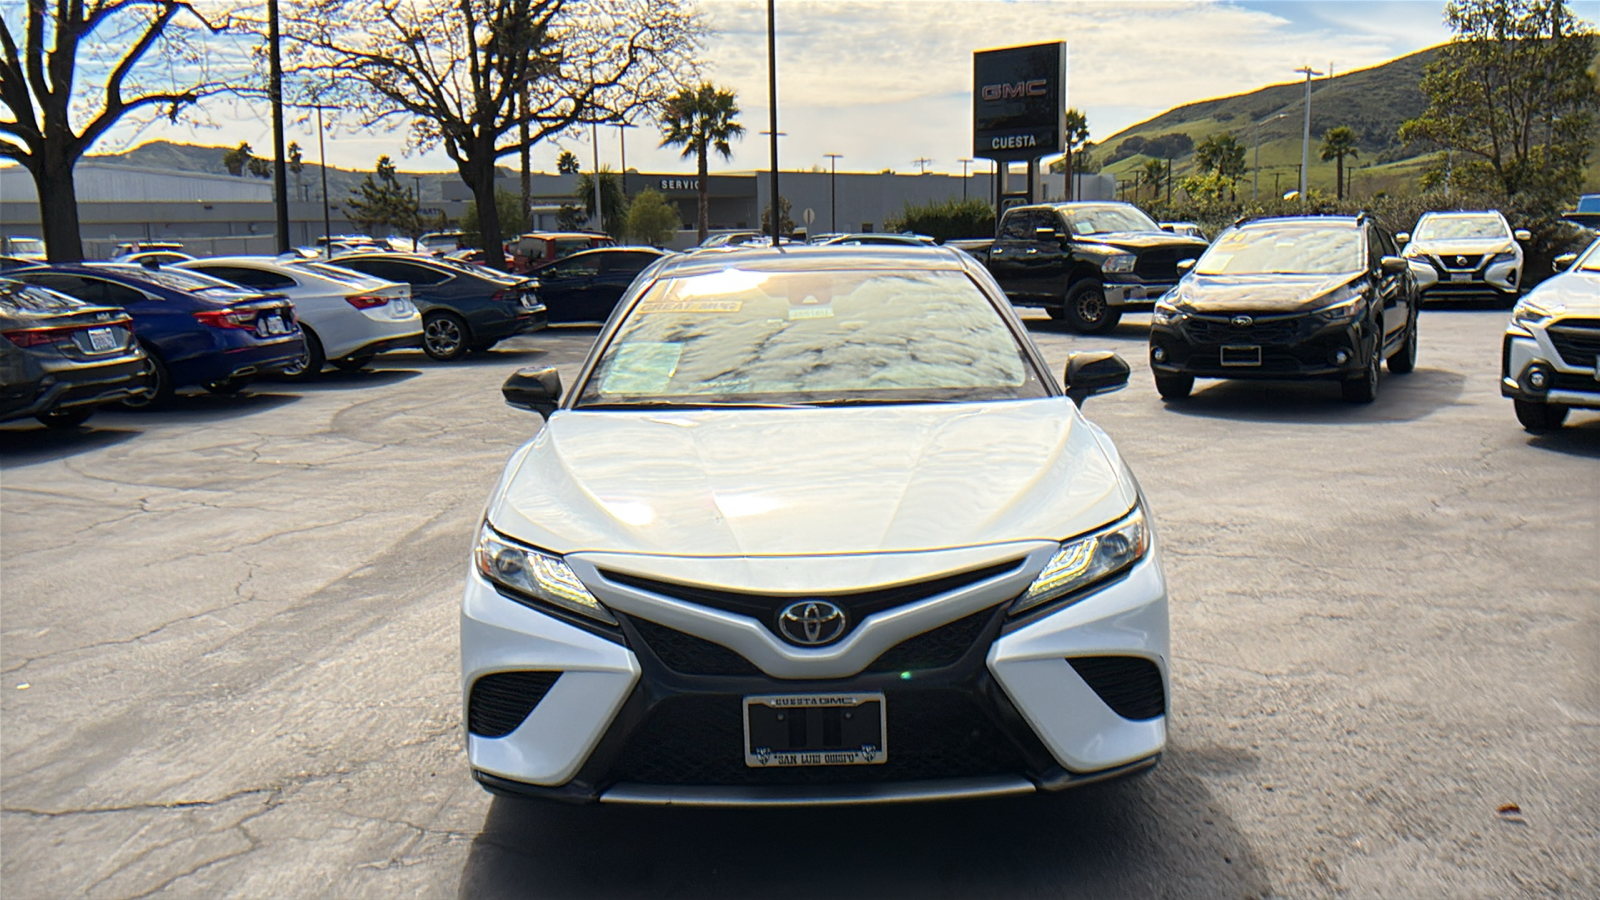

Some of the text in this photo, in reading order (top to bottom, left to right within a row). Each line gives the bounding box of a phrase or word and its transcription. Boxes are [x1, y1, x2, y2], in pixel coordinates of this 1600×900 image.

[982, 79, 1047, 100] GMC
[992, 135, 1036, 149] CUESTA
[661, 180, 699, 189] SERVIC
[778, 755, 797, 765] SAN
